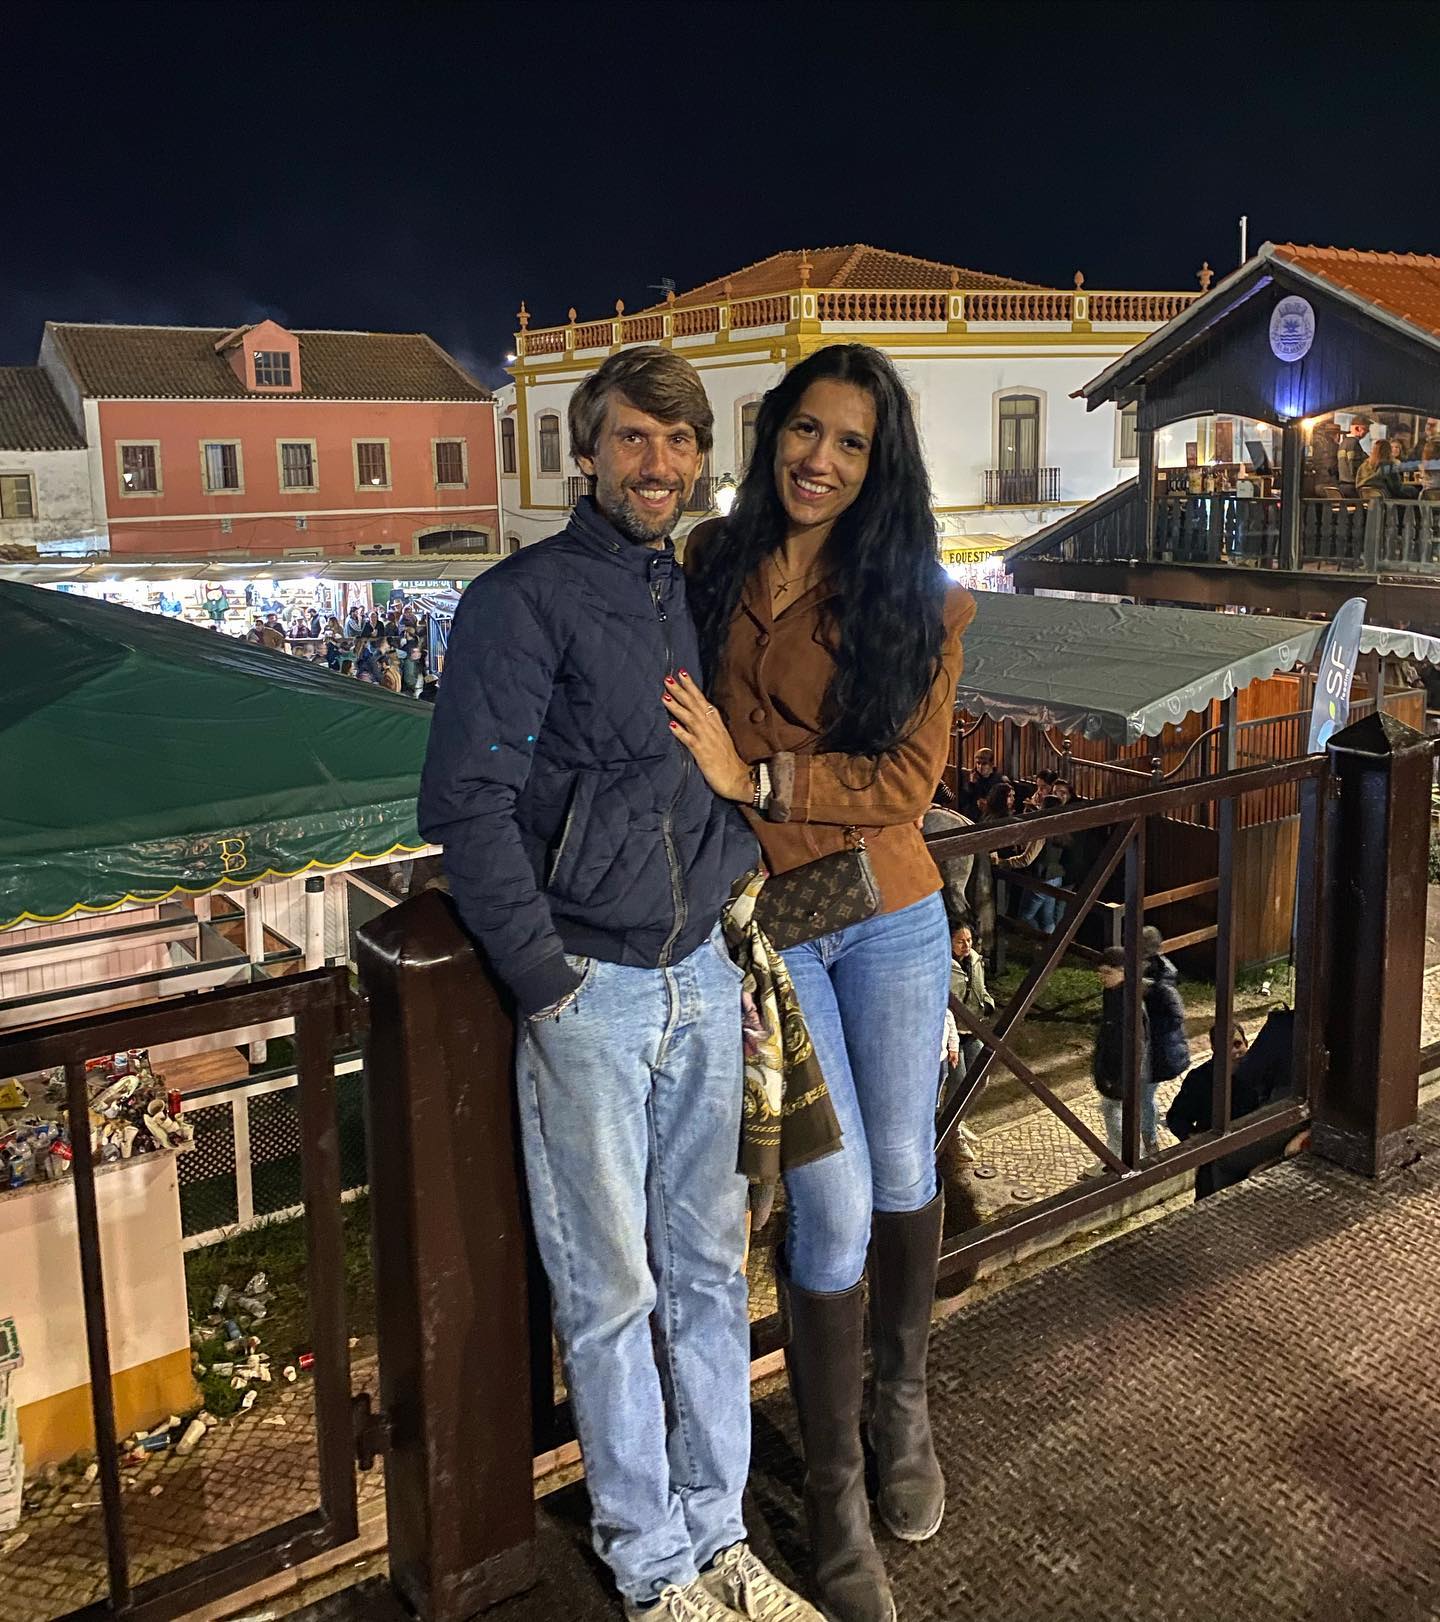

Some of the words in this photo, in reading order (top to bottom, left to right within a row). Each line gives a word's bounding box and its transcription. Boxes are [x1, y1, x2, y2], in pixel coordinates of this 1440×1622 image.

[949, 550, 996, 565] EQUESTR
[1326, 640, 1346, 698] SF
[216, 838, 247, 874] B
